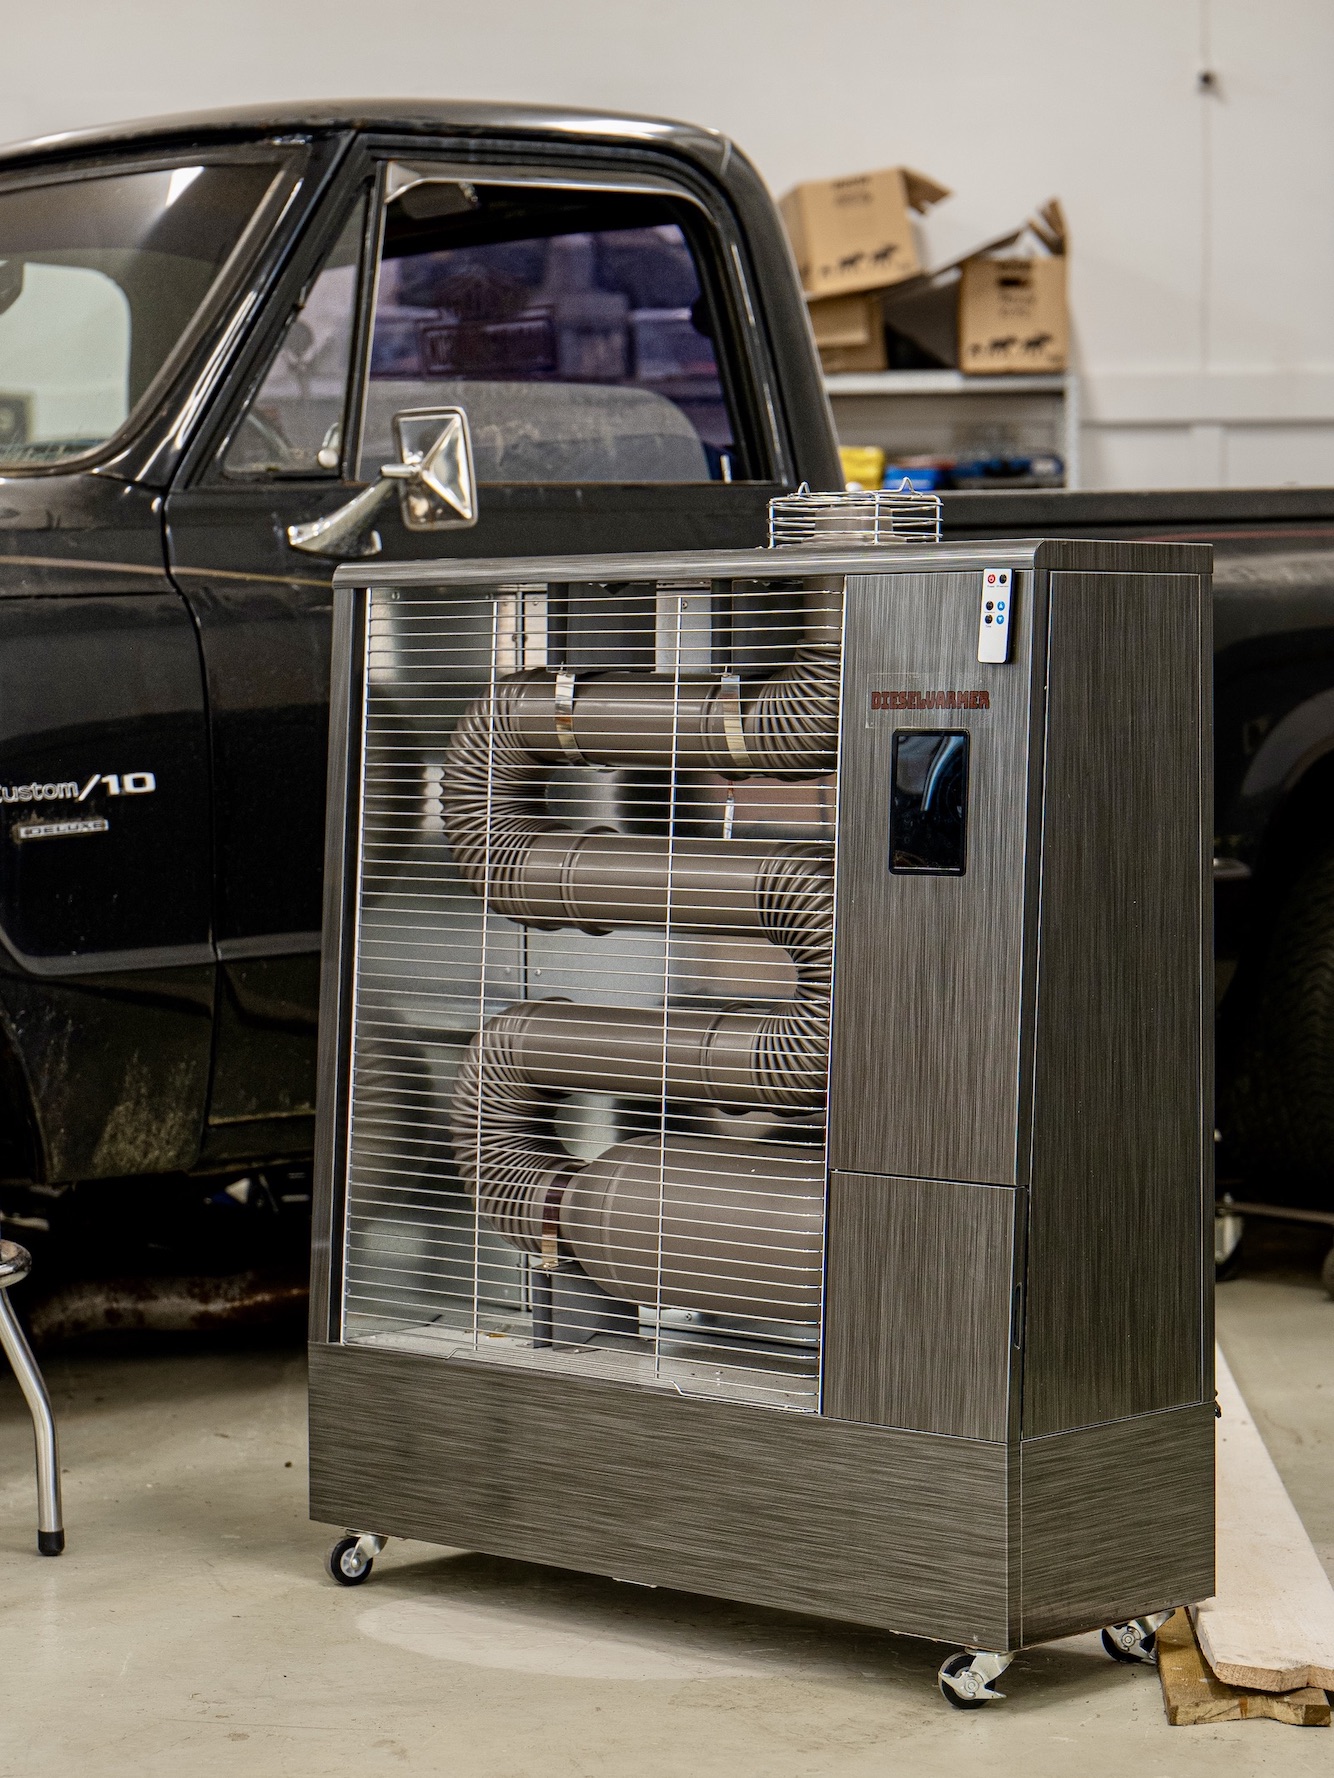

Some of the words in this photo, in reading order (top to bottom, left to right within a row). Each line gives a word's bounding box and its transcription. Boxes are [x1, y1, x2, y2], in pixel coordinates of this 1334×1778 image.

[871, 690, 990, 710] DIESELWARMER
[0, 772, 156, 803] ustom/10
[23, 822, 104, 836] DELUXE
